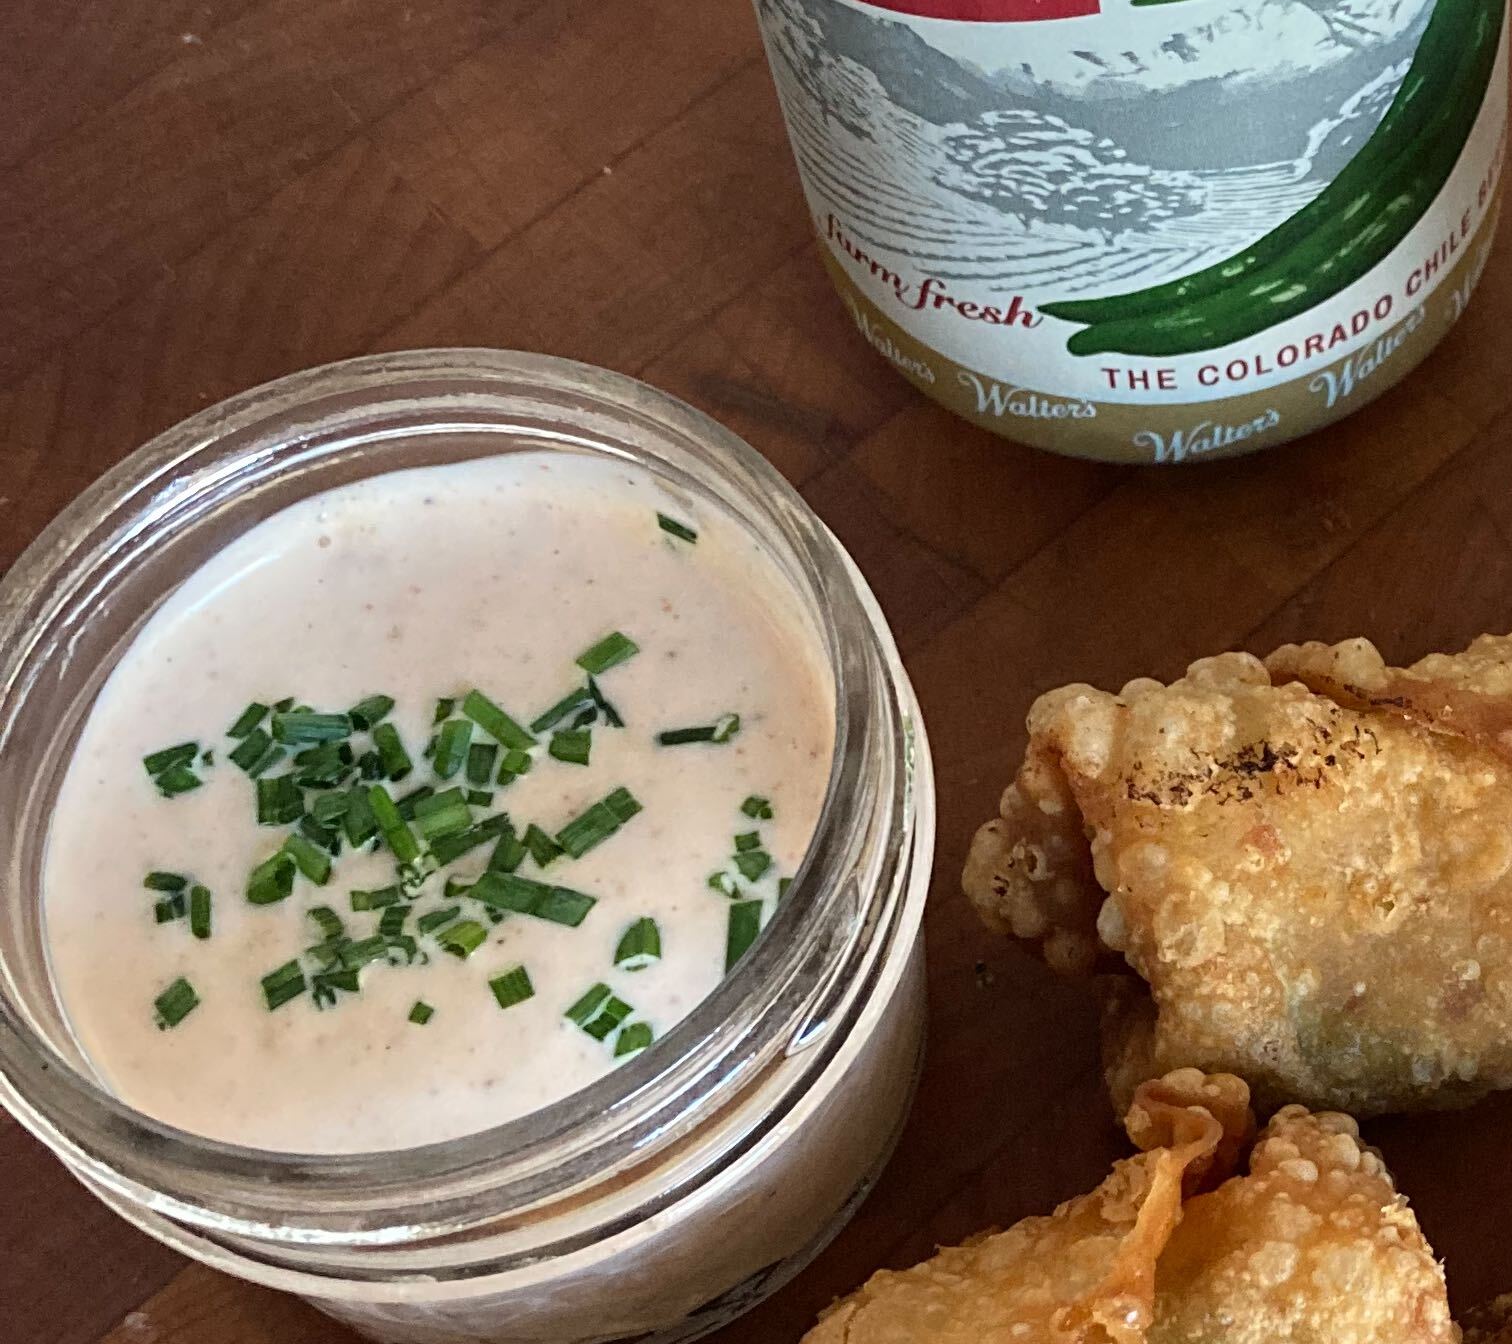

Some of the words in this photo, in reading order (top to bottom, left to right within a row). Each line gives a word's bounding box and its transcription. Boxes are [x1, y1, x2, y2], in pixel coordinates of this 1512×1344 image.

[826, 213, 909, 292] farm
[896, 277, 1044, 329] fresh
[1103, 367, 1179, 392] THE
[1198, 293, 1394, 388] COLORADO
[1405, 207, 1471, 298] CHILE
[957, 371, 1097, 420] Walter's
[1134, 408, 1281, 464] Walter's
